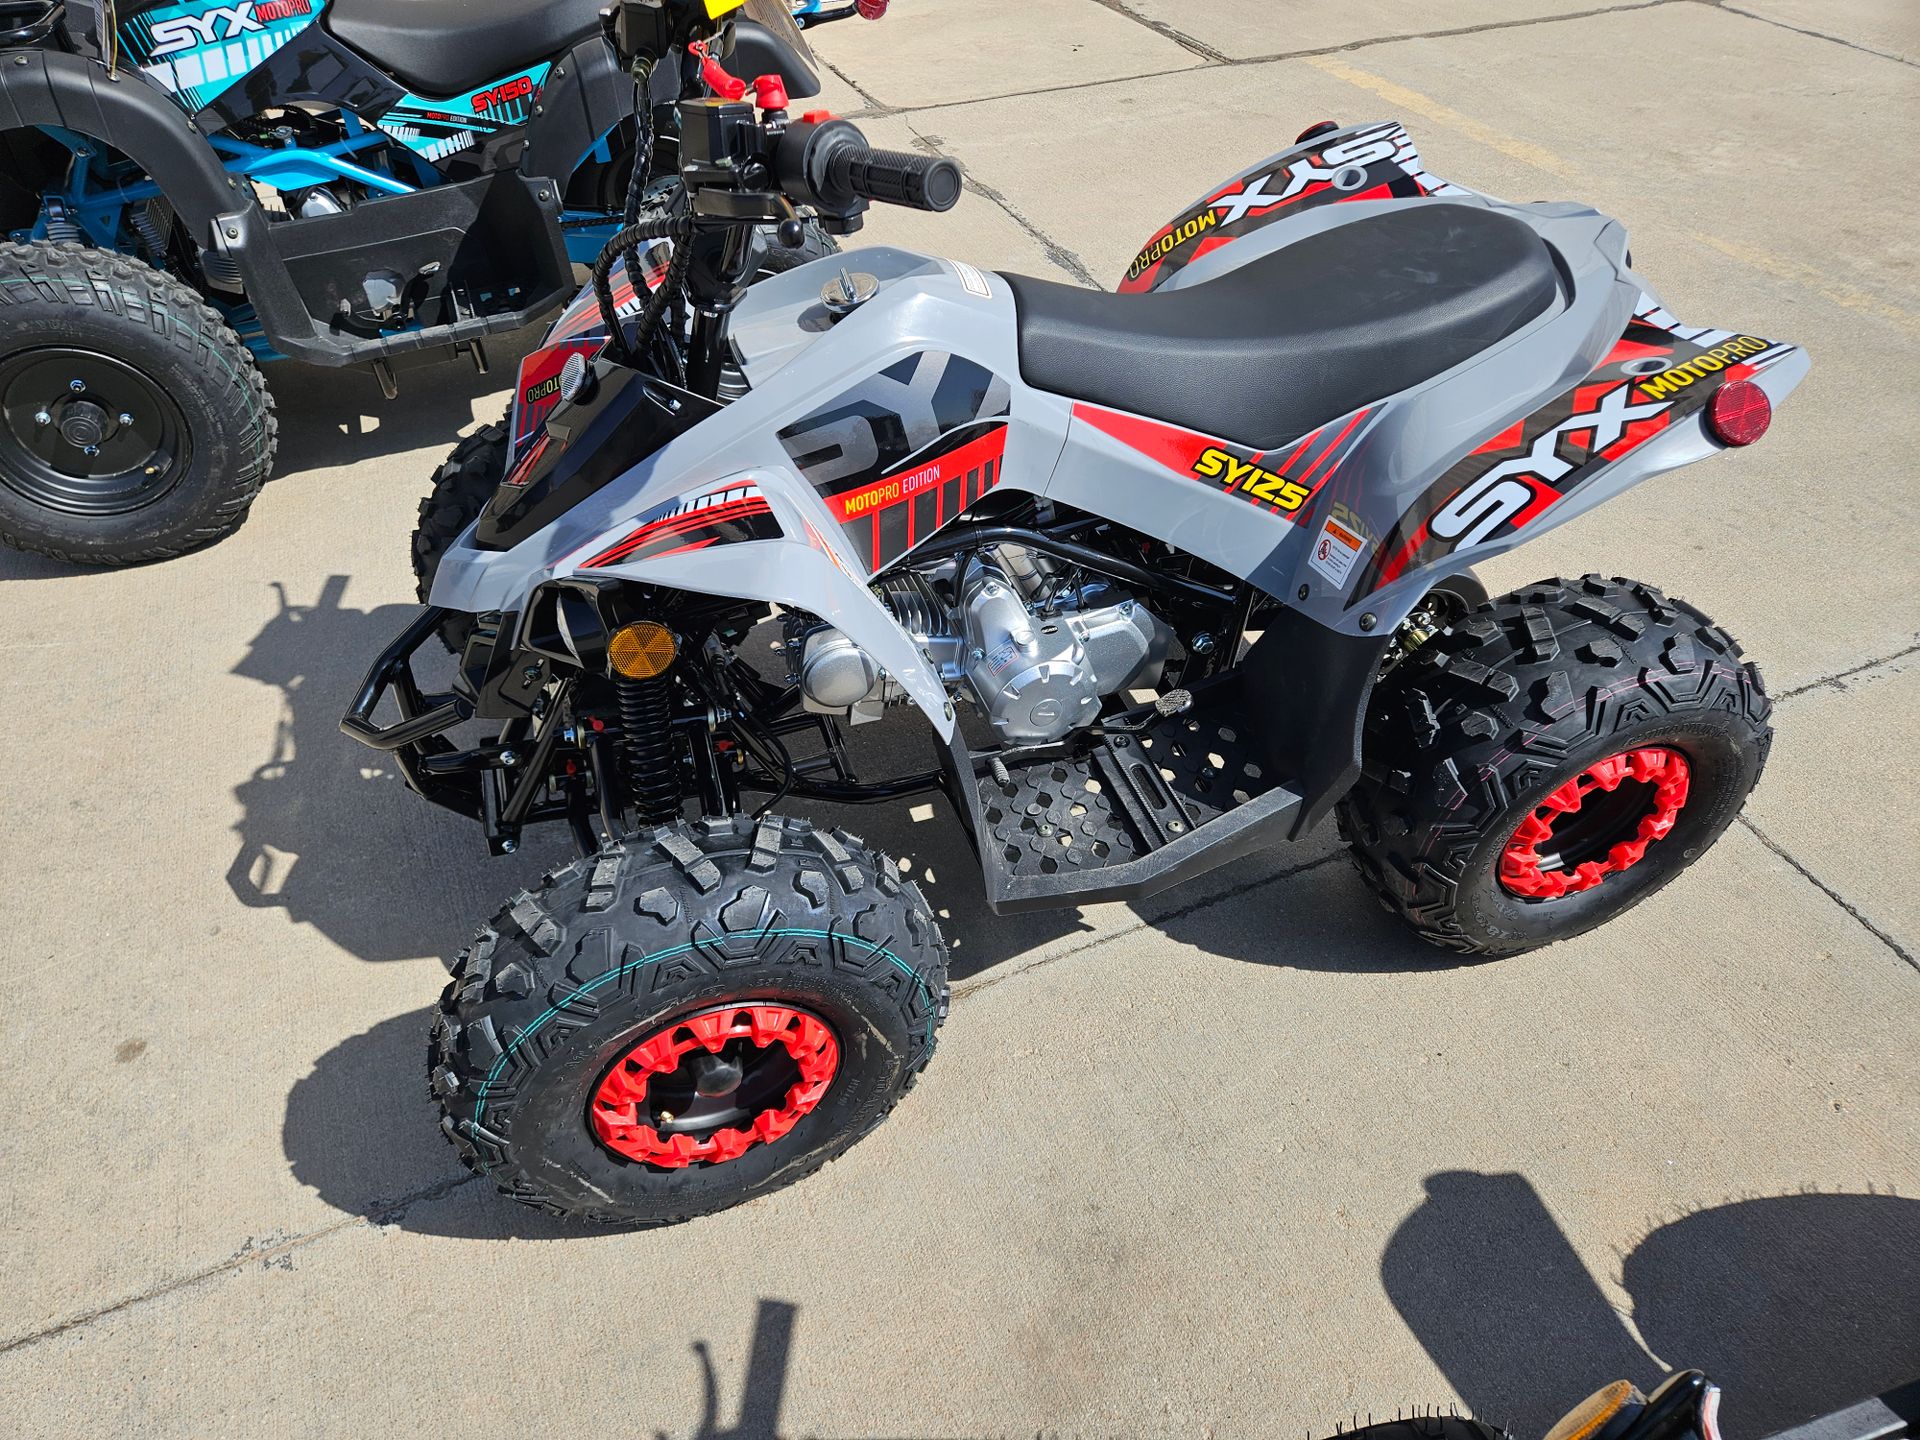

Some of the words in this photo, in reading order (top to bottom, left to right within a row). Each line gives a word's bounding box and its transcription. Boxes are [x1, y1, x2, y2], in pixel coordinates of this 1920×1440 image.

[150, 1, 264, 57] SYX
[256, 0, 312, 22] MOTOPRO
[472, 77, 532, 113] SY150
[1129, 209, 1216, 279] MOTOPRO
[1638, 334, 1770, 400] MOTOPRO
[845, 482, 900, 515] MOTOPRO
[902, 464, 941, 494] EDITION
[1194, 448, 1310, 511] SY125
[1431, 383, 1676, 554] SYX
